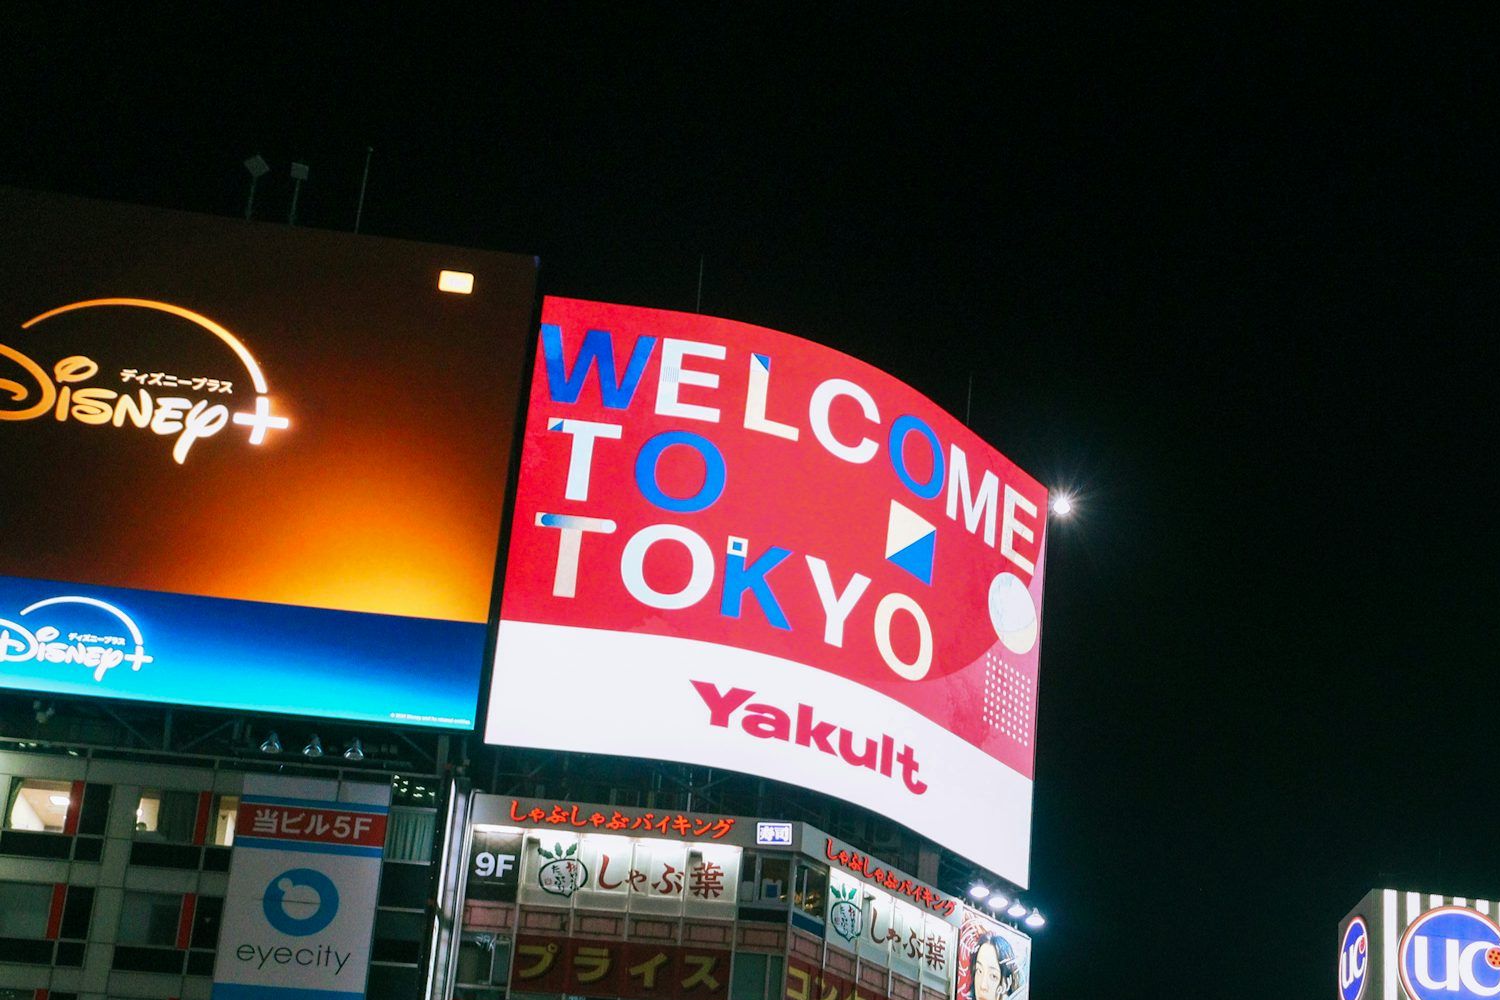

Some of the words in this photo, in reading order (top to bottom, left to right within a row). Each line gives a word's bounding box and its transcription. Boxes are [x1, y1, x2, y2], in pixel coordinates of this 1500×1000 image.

[120, 369, 232, 394] ディズニープラス
[540, 323, 1038, 576] WELCOME
[547, 417, 726, 513] TO
[535, 512, 933, 681] TOKYO
[689, 679, 928, 795] Yakult
[252, 809, 372, 841] 当ビル5F
[510, 800, 735, 838] しゃぶしゃぶバイキング
[475, 852, 515, 877] 9F
[600, 854, 724, 899] しゃぶ葉
[826, 838, 955, 916] しゃぶしゃぶバイキング
[237, 942, 351, 976] eyecity
[870, 907, 946, 971] しゃぶ葉
[518, 945, 721, 989] プライス
